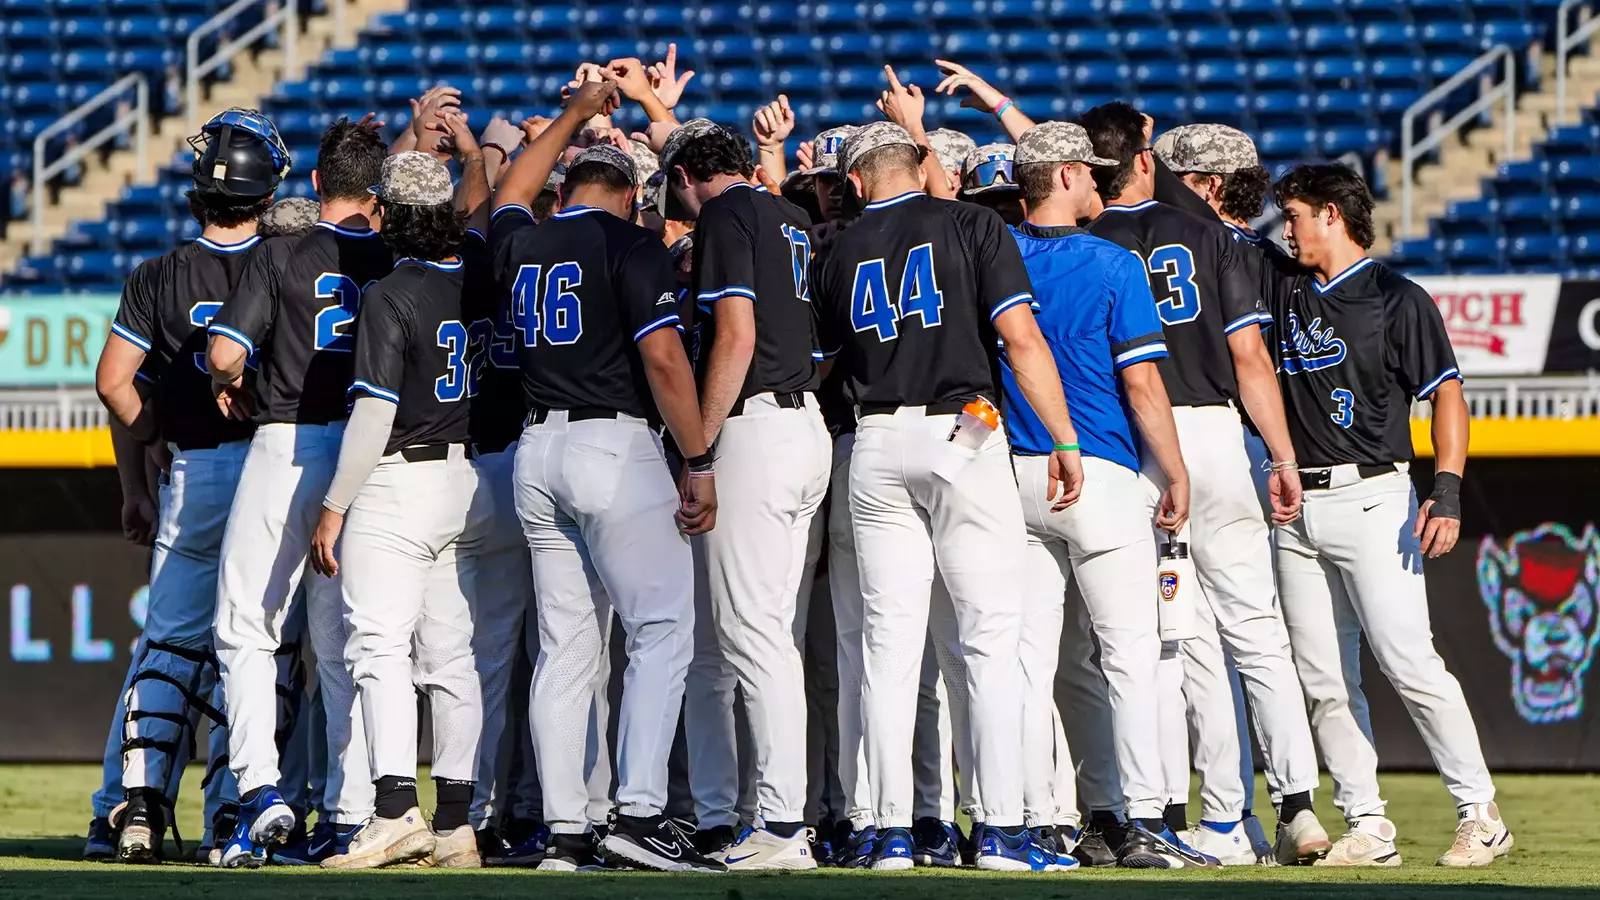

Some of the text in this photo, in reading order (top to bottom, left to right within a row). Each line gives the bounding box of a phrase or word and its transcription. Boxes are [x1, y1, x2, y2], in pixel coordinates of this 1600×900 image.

[313, 272, 379, 352] 2
[511, 261, 583, 347] 46
[850, 242, 944, 343] 44
[1130, 243, 1202, 326] 3
[433, 320, 494, 403] 32
[1330, 388, 1354, 428] 3
